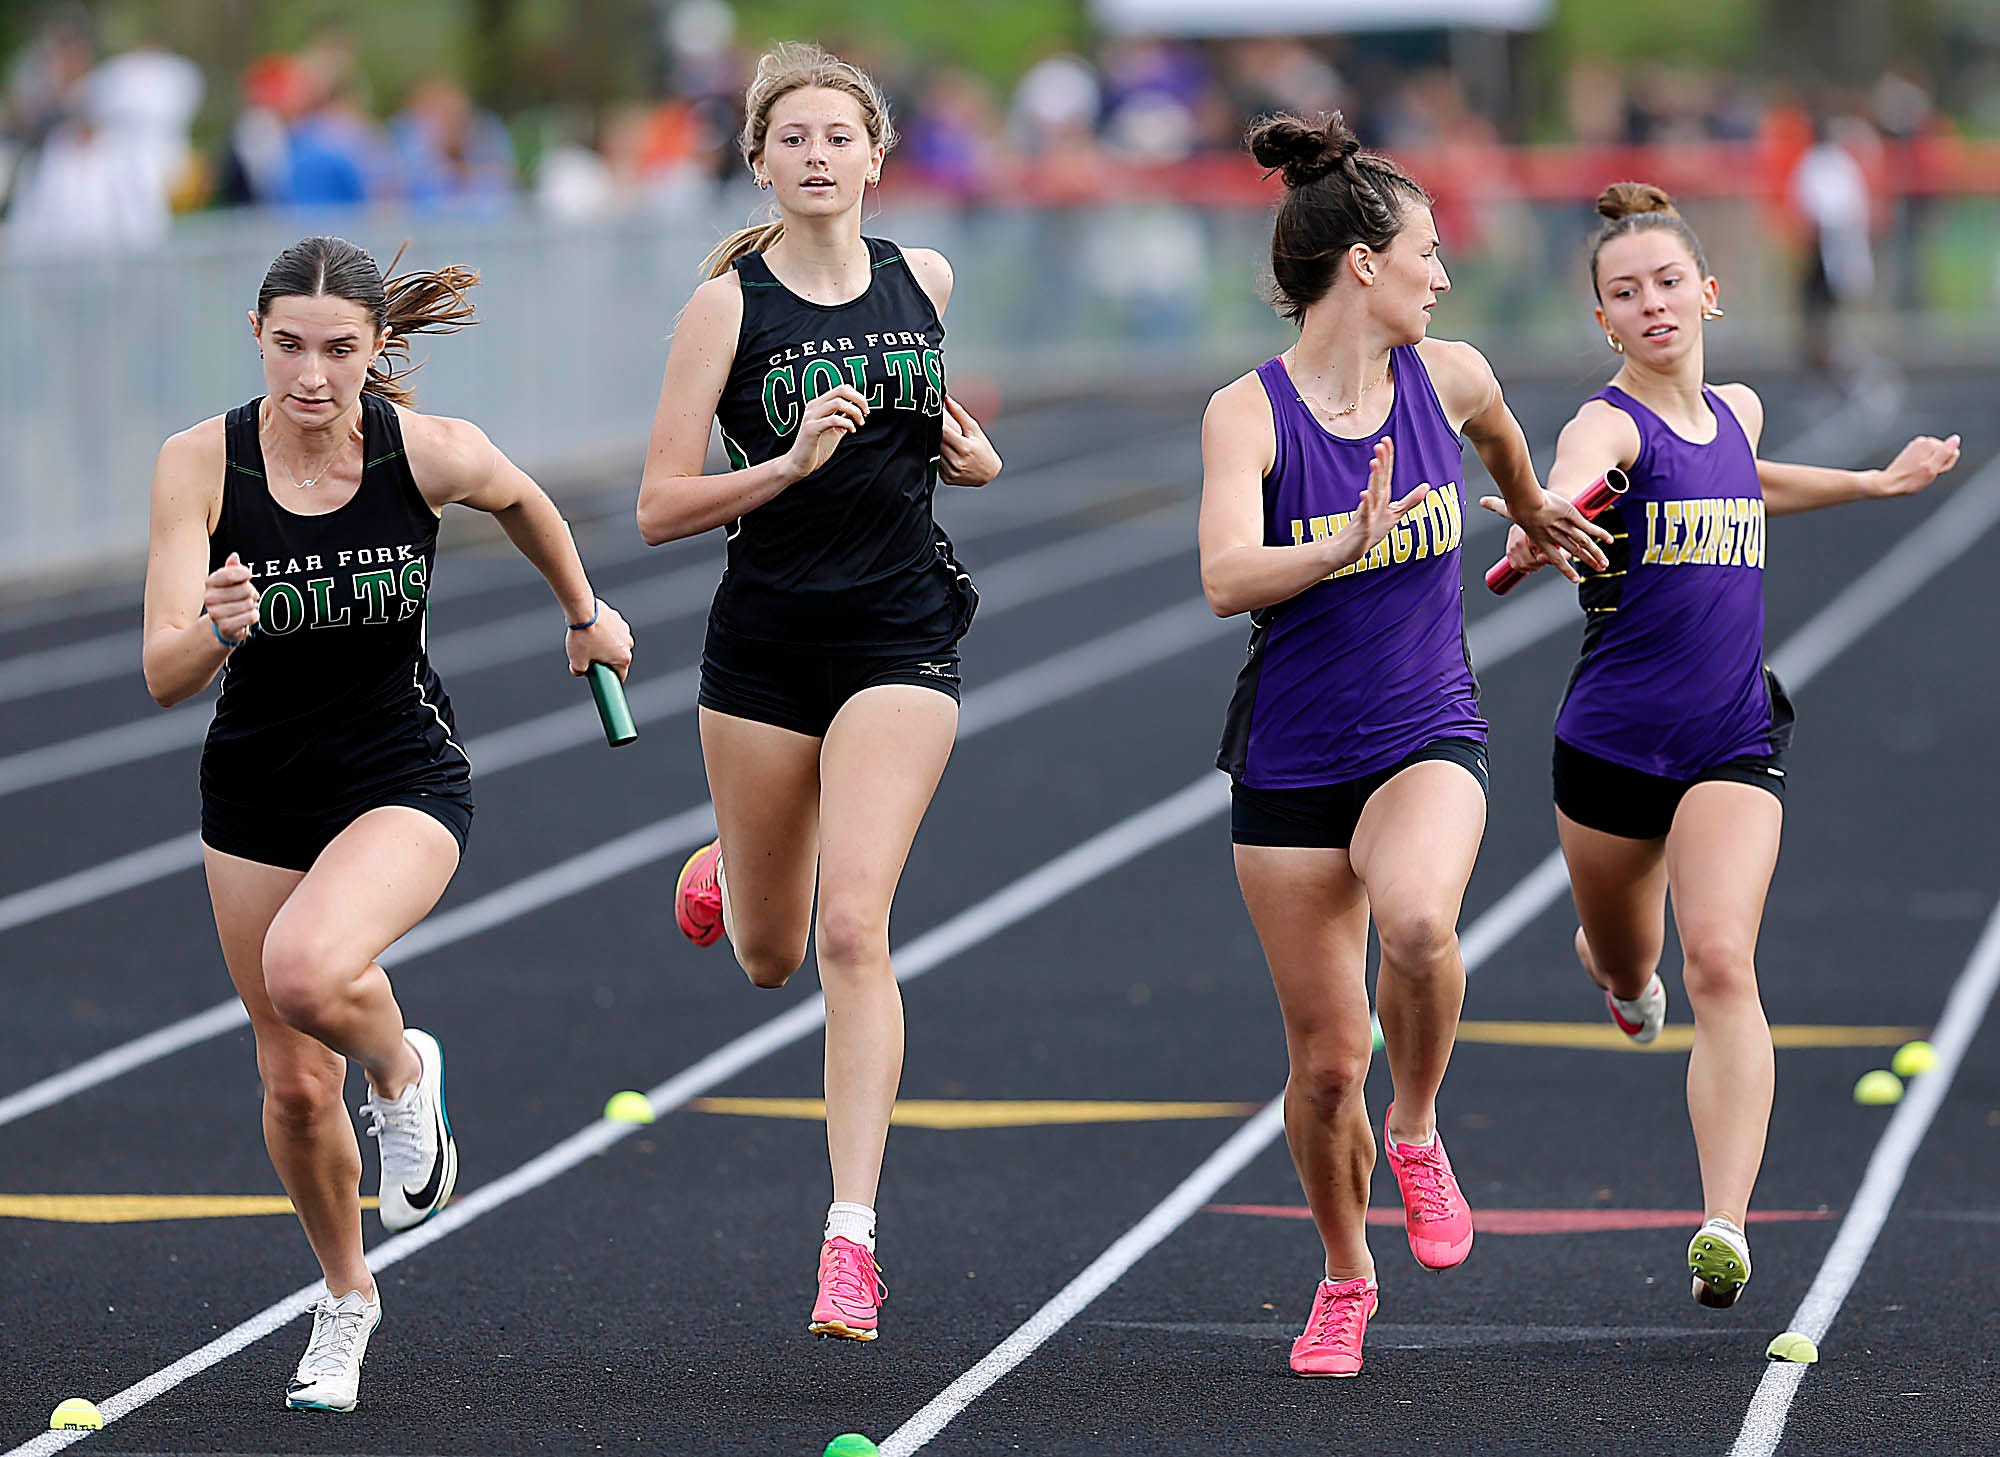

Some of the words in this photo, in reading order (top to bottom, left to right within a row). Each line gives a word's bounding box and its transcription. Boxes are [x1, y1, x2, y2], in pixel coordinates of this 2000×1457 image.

[769, 337, 855, 366] CLEAR
[865, 331, 930, 348] FORK
[762, 348, 944, 437] COLTS
[248, 554, 323, 578] LEAR
[338, 544, 415, 567] FORK
[1291, 482, 1463, 581] NGTON
[258, 554, 427, 636] OLTS
